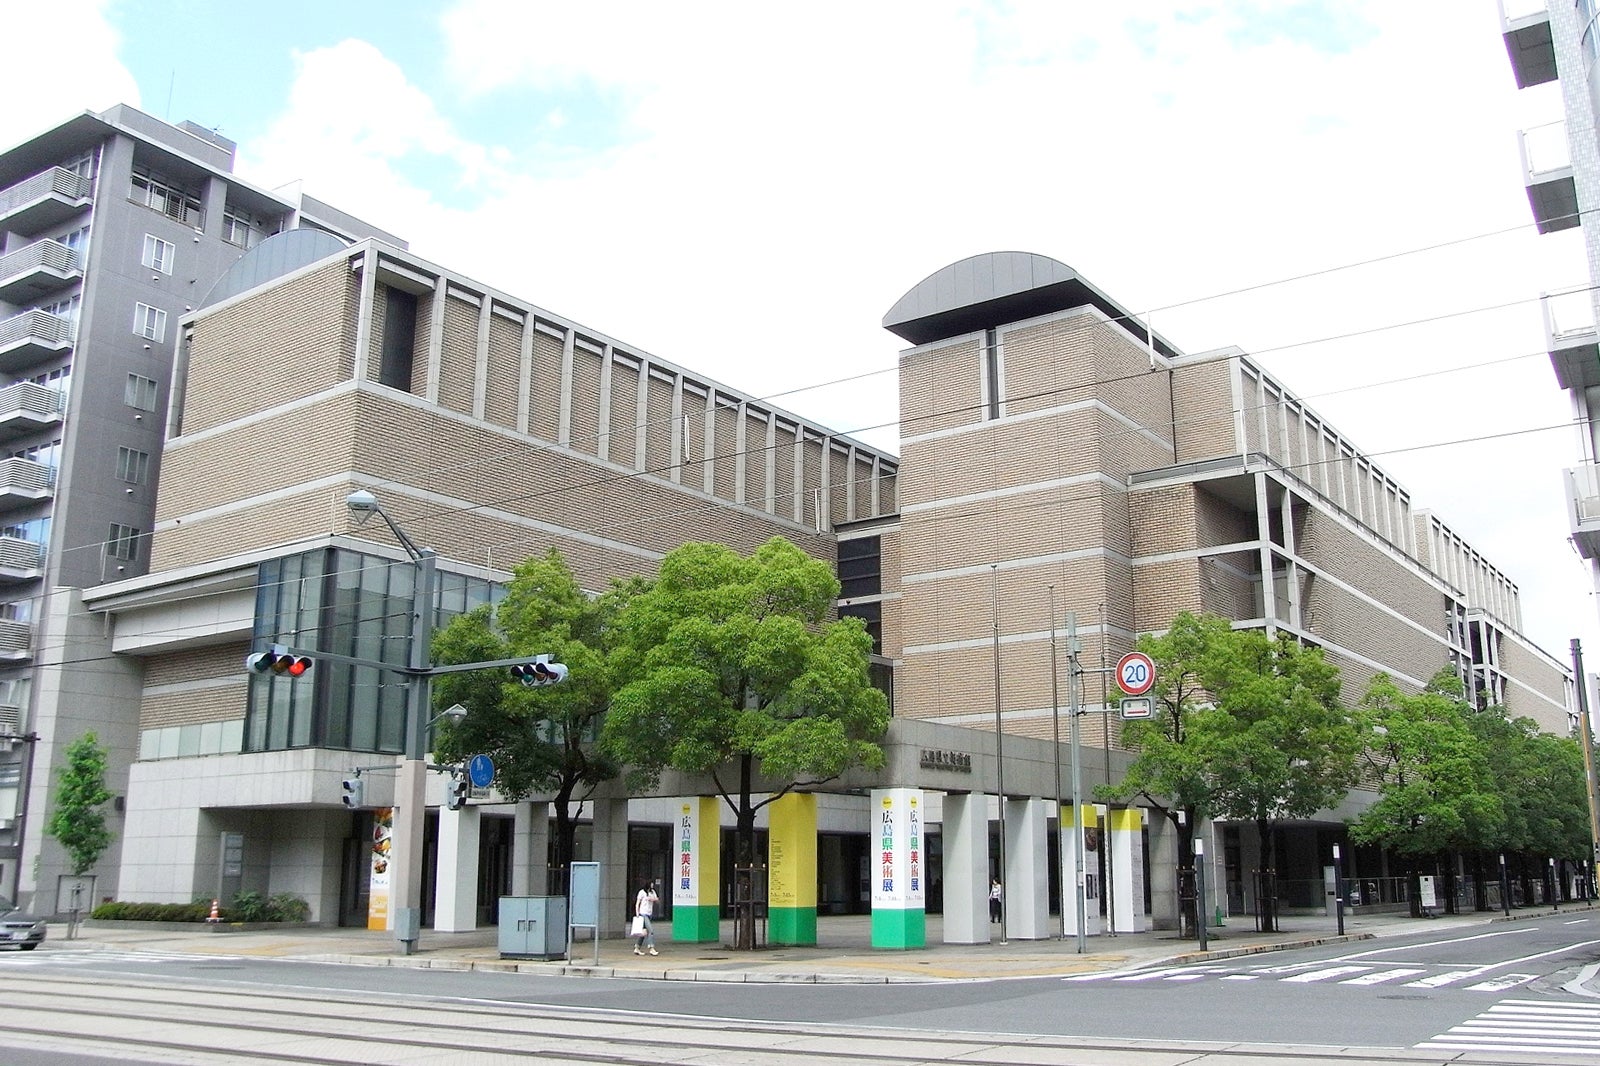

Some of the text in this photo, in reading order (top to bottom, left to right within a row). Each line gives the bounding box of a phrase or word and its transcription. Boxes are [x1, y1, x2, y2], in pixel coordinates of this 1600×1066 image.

[1125, 664, 1146, 683] 20
[681, 815, 691, 890] 広島県美術展
[881, 809, 894, 892] 広島県美術展
[909, 809, 919, 892] 広島県美術展
